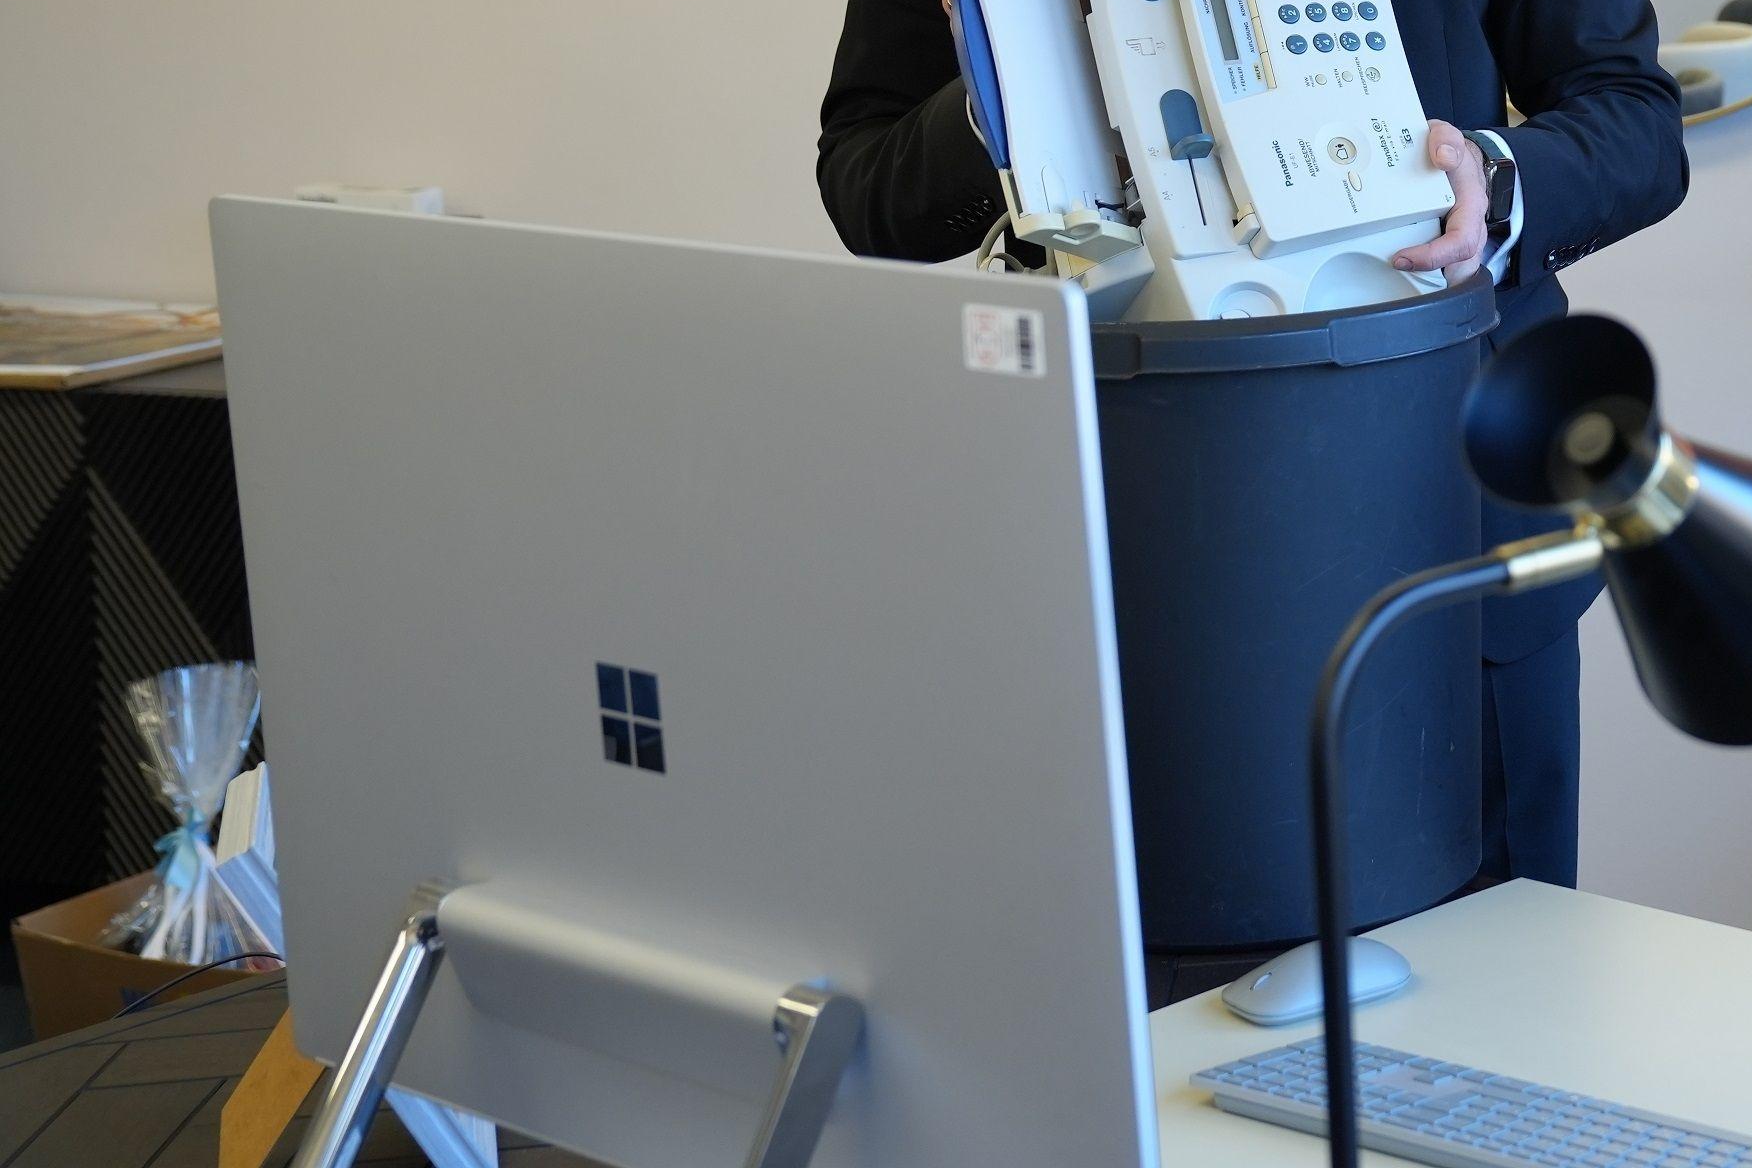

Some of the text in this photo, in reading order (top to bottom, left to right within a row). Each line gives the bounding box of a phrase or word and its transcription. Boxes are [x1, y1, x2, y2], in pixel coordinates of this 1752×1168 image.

[1243, 21, 1255, 53] AUFLÖSUNG
[1237, 66, 1246, 88] FEHLER
[1253, 64, 1261, 80] HILFE
[1334, 68, 1343, 88] HALTEN
[1355, 56, 1369, 95] FREISPRECHEN
[1379, 135, 1395, 168] Panafax
[1401, 128, 1412, 143] G3
[1272, 140, 1294, 187] Panasonic
[1343, 179, 1359, 214] WIEDERGABE
